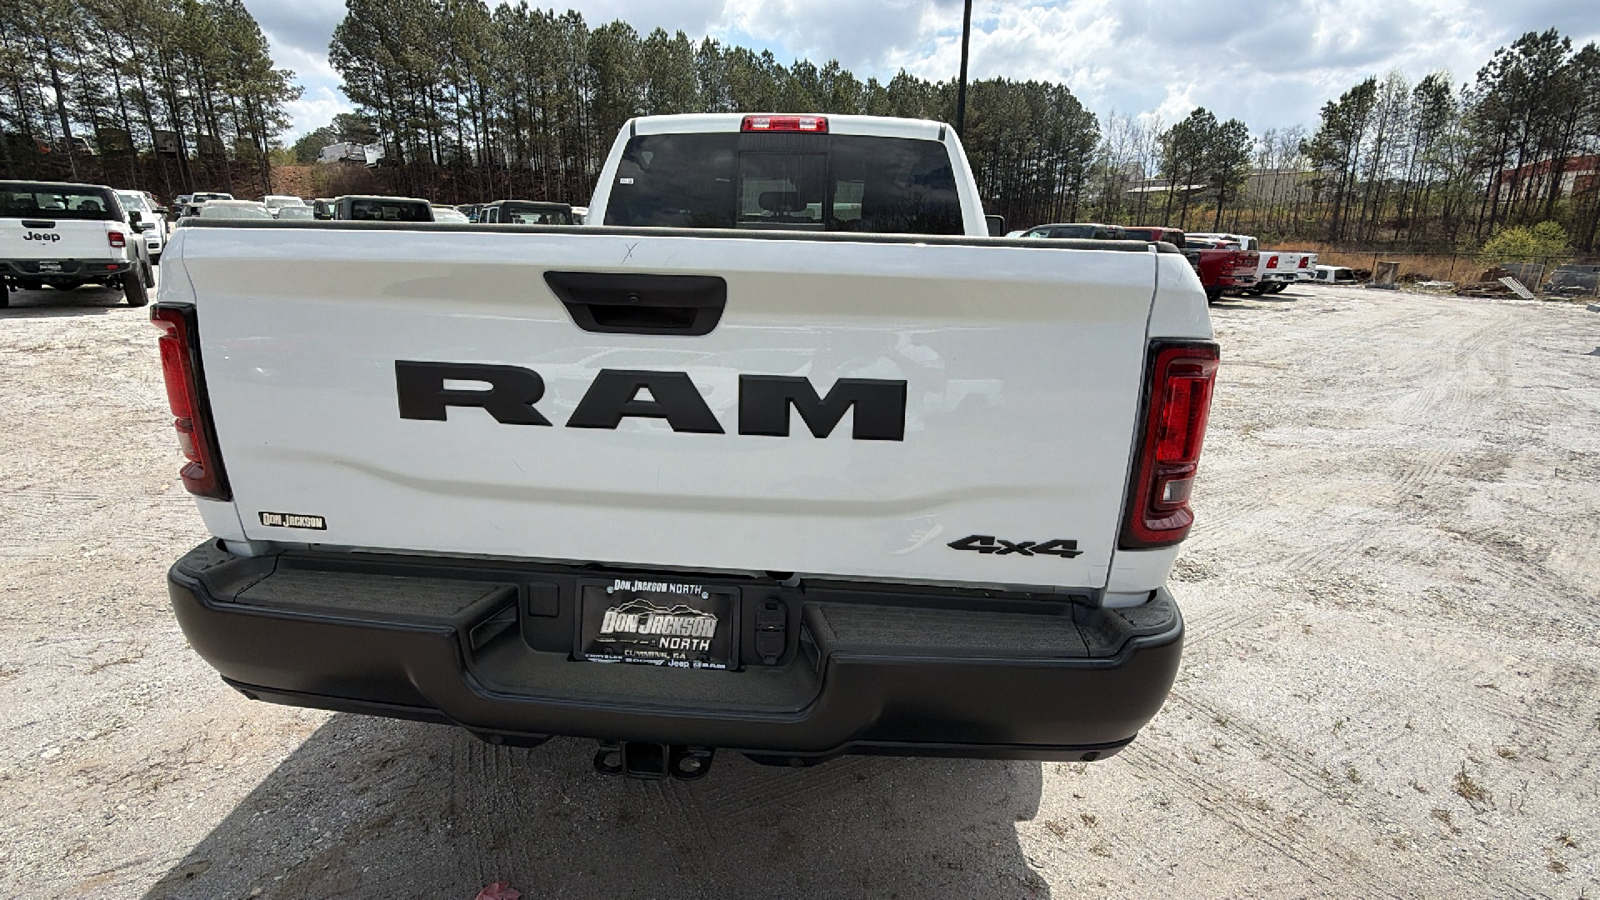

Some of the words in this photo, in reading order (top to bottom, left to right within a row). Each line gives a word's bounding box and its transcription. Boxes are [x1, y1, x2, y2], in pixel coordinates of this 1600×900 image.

[23, 231, 60, 243] Jeep
[395, 359, 908, 441] RAM
[262, 512, 282, 526] DON
[283, 514, 323, 528] JACKSON
[614, 579, 631, 591] DON
[631, 580, 667, 592] JACKSON
[669, 583, 702, 594] NORTH
[600, 611, 640, 633] DON
[638, 613, 718, 638] JACKSON
[659, 637, 711, 651] NORTH
[668, 659, 689, 669] Jeep
